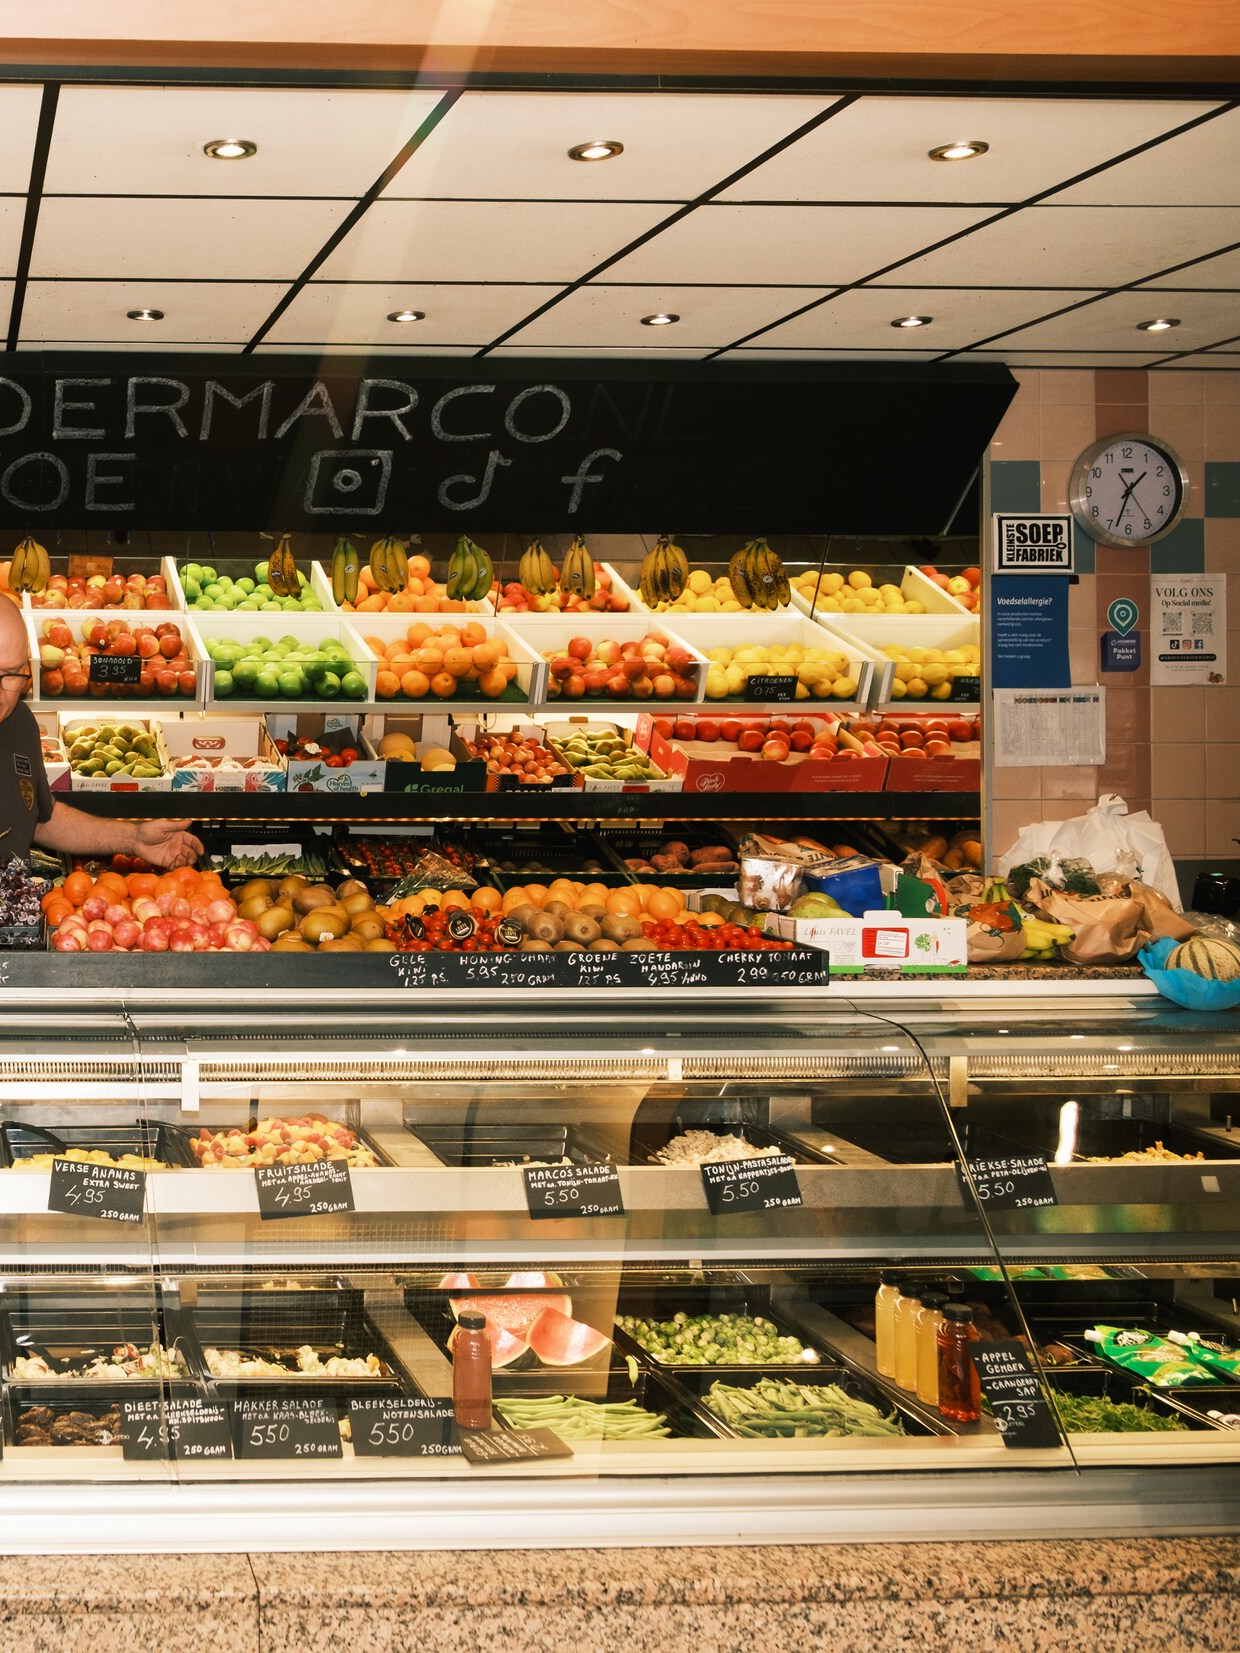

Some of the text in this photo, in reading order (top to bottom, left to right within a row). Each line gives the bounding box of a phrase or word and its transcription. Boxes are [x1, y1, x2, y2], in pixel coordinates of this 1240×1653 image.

[1105, 453, 1114, 464] 11
[1121, 447, 1133, 459] 12
[1144, 453, 1149, 464] 1
[1091, 467, 1102, 478] 10
[1156, 466, 1164, 477] 2
[1085, 487, 1092, 498] 9
[1162, 486, 1170, 496] 3
[1092, 507, 1099, 518] 8
[1156, 505, 1164, 516] 4
[1106, 520, 1113, 530] 7
[1124, 524, 1132, 534] 6
[1143, 519, 1152, 530] 5
[1005, 523, 1063, 562] KLEINSTE SOEP
[1016, 548, 1063, 562] FABRIEK
[1155, 587, 1213, 598] VOLG ONS
[997, 597, 1053, 607] Voedselallergie?
[93, 657, 133, 665] JONAGOLD
[829, 928, 857, 936] FAVEL
[568, 953, 618, 966] GROENE
[630, 953, 671, 965] ZOETE
[718, 952, 762, 964] CHERRY
[54, 1162, 136, 1180] VERSE ANANAS
[576, 1166, 610, 1176] SALADE
[82, 1178, 140, 1190] EXTRA SWEET
[64, 1185, 106, 1206] 4.95
[275, 1185, 312, 1207] 4.95
[722, 1182, 760, 1202] 5.50
[978, 1181, 1014, 1200] 5.50
[544, 1188, 579, 1206] 5.50
[764, 1196, 801, 1208] 250 GRAM
[1015, 1197, 1054, 1207] 250 GRAM
[310, 1202, 348, 1213] 250 GRAM
[580, 1204, 619, 1214] 250 GRAM
[100, 1210, 140, 1221] 250 GRAM
[982, 1352, 1016, 1364] APPEL
[986, 1363, 1026, 1374] GEMBER
[1016, 1386, 1037, 1398] SAP
[234, 1400, 324, 1412] HAKKER SALADE
[382, 1409, 455, 1420] NOTENSALADE
[184, 1445, 226, 1456] 250 GRAM
[294, 1443, 338, 1454] 250 GRAM
[421, 1444, 462, 1455] 250 GRAM
